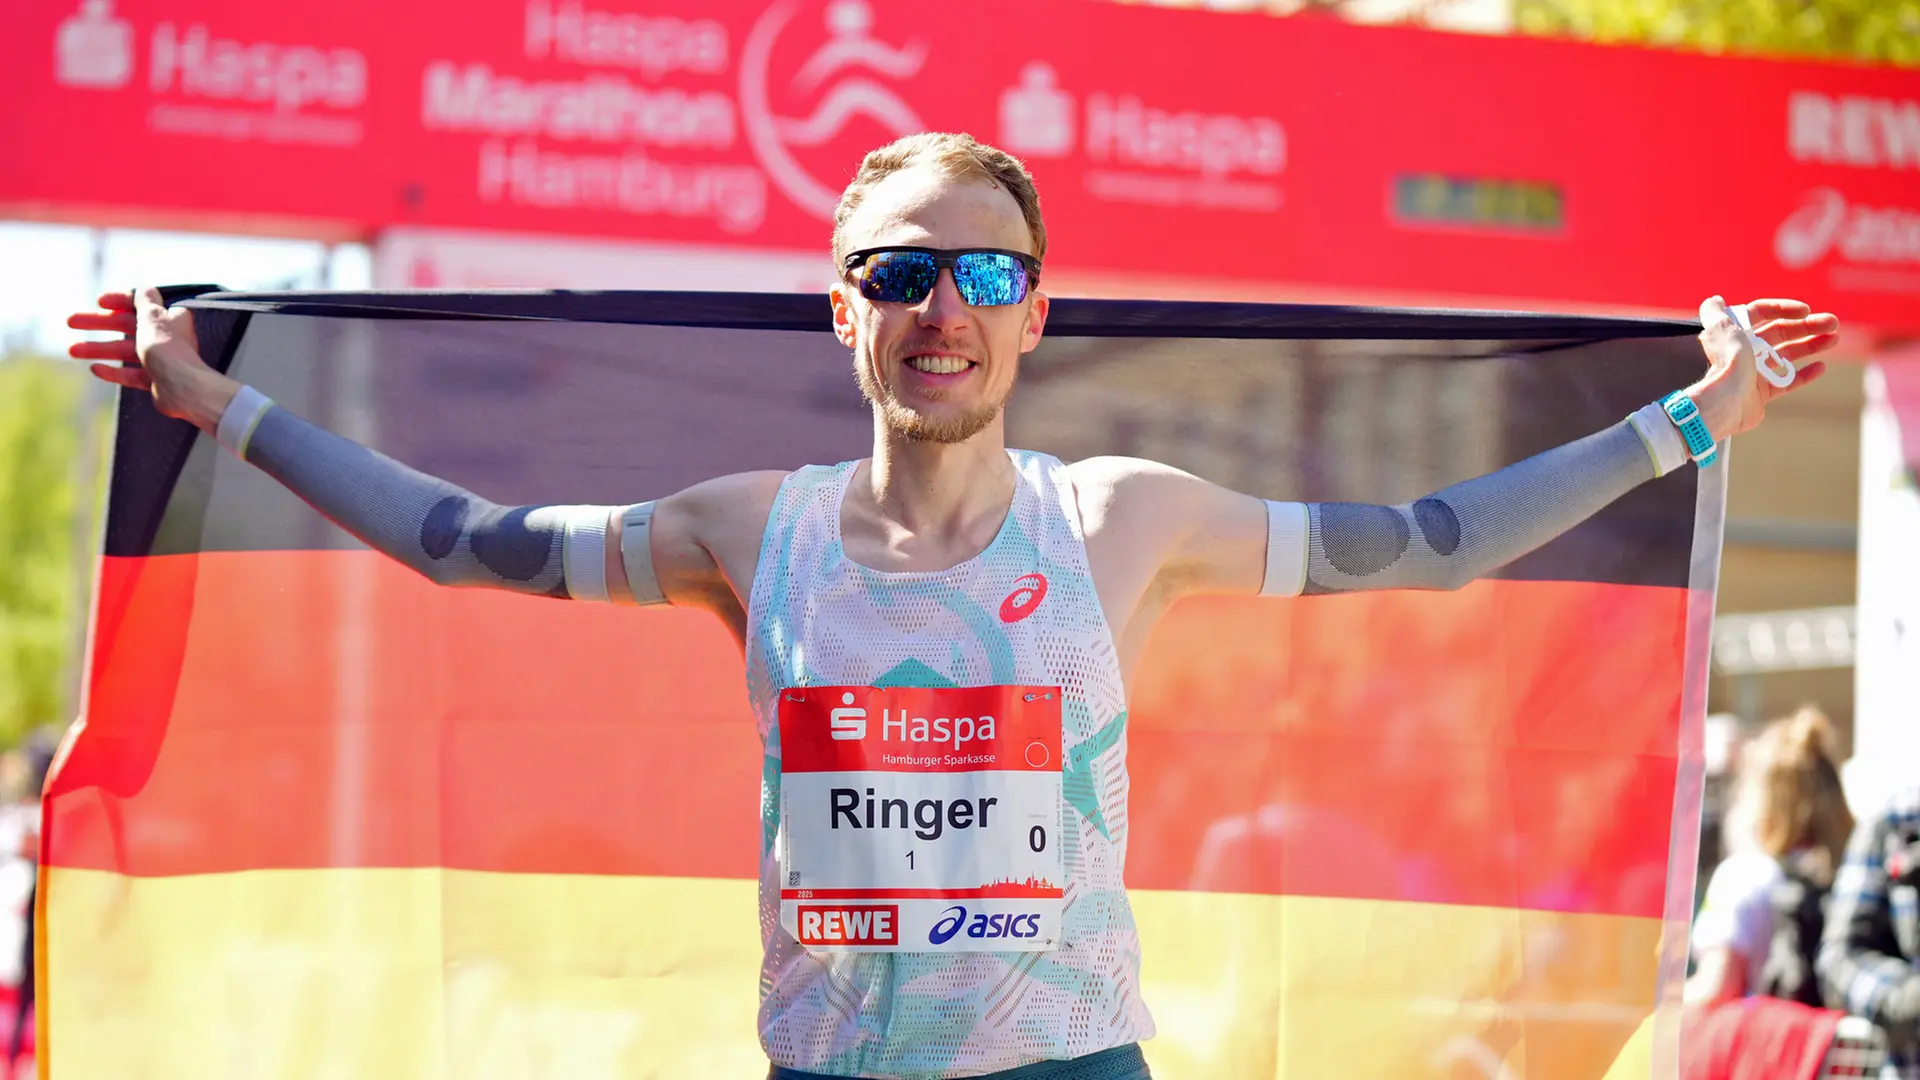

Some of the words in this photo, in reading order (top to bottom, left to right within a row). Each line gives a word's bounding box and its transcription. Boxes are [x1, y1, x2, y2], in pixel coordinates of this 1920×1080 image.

[525, 1, 728, 78] Haspa
[151, 21, 367, 117] Haspa
[423, 60, 735, 149] Marathon
[1085, 93, 1288, 178] Haspa
[479, 138, 766, 233] Hamburg
[882, 708, 996, 750] Haspa
[882, 753, 942, 767] Hamburger
[944, 753, 996, 767] Sparkasse
[830, 788, 998, 840] Ringer
[1029, 825, 1046, 853] 0
[905, 851, 915, 870] 1
[797, 890, 814, 898] 2025
[802, 910, 893, 940] REWE
[967, 913, 1041, 938] asics
